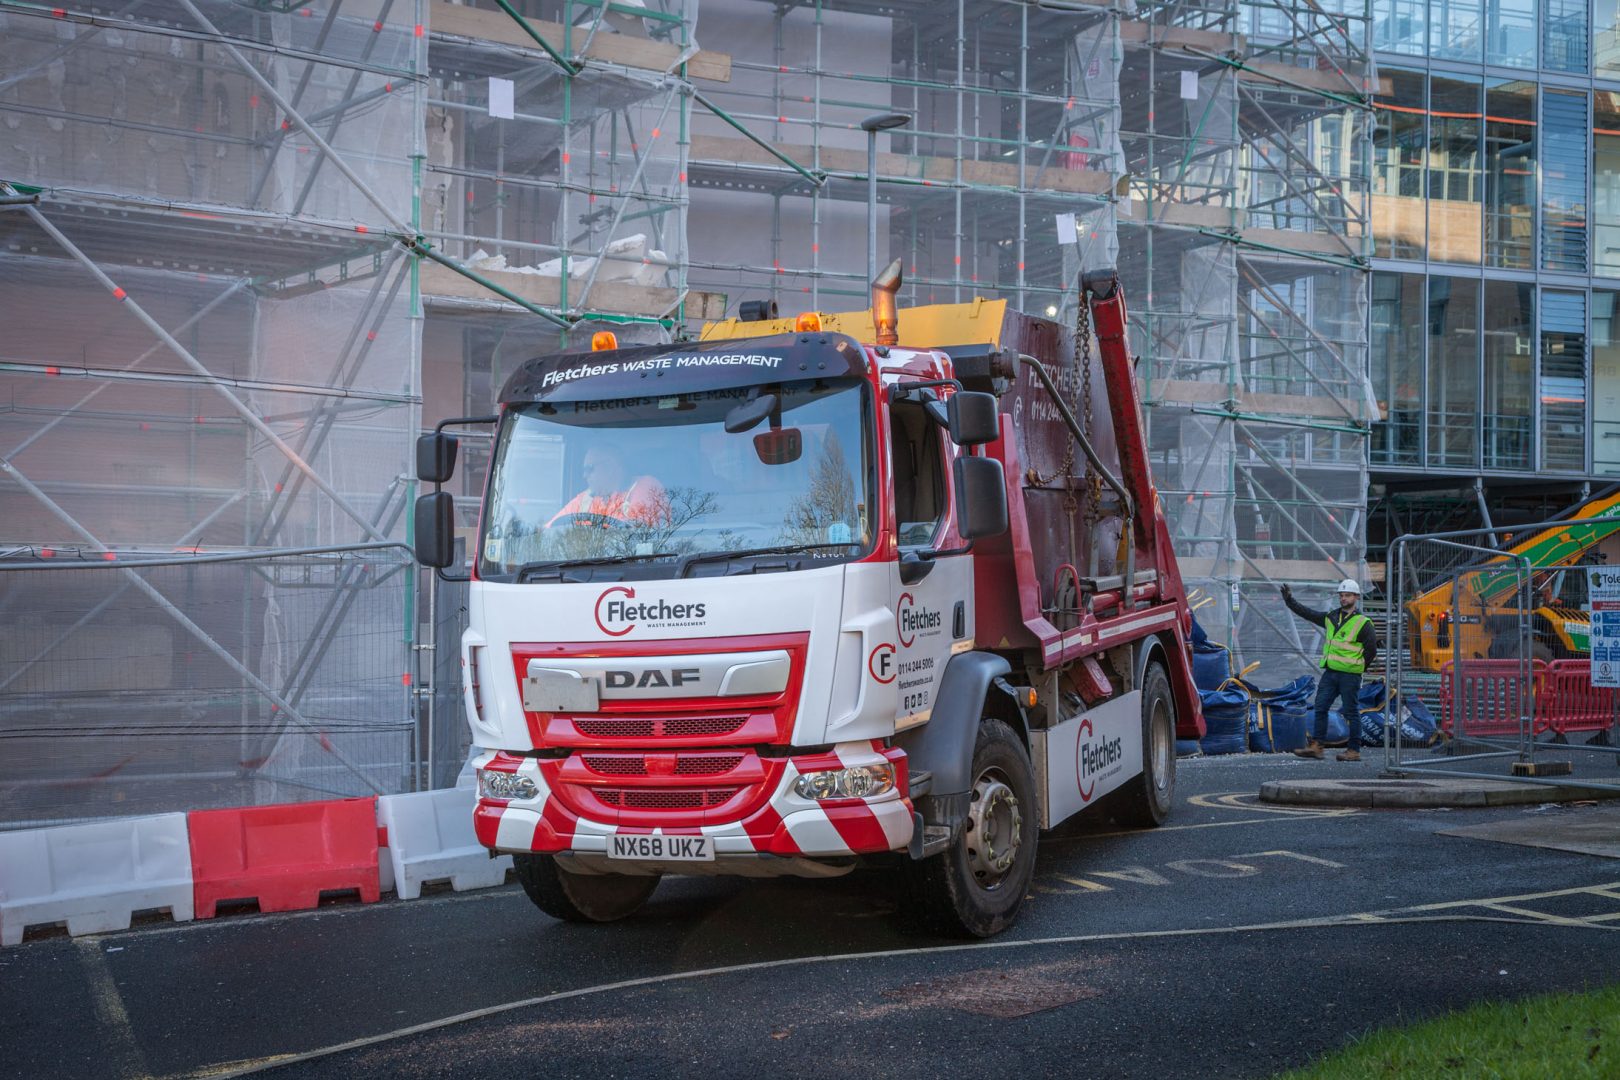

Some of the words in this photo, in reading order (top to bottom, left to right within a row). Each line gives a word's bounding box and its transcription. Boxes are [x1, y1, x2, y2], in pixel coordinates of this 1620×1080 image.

[542, 361, 618, 387] Fletchers
[623, 358, 672, 372] WASTE
[676, 355, 782, 368] MANAGEMENT
[607, 599, 706, 622] Fletchers
[902, 607, 941, 632] Fletchers
[880, 653, 891, 676] F
[898, 662, 911, 675] 0114
[912, 660, 922, 672] 244
[605, 668, 700, 688] DAF
[1082, 734, 1121, 779] Fletchers
[614, 837, 663, 856] NX68
[668, 838, 706, 857] UKZ
